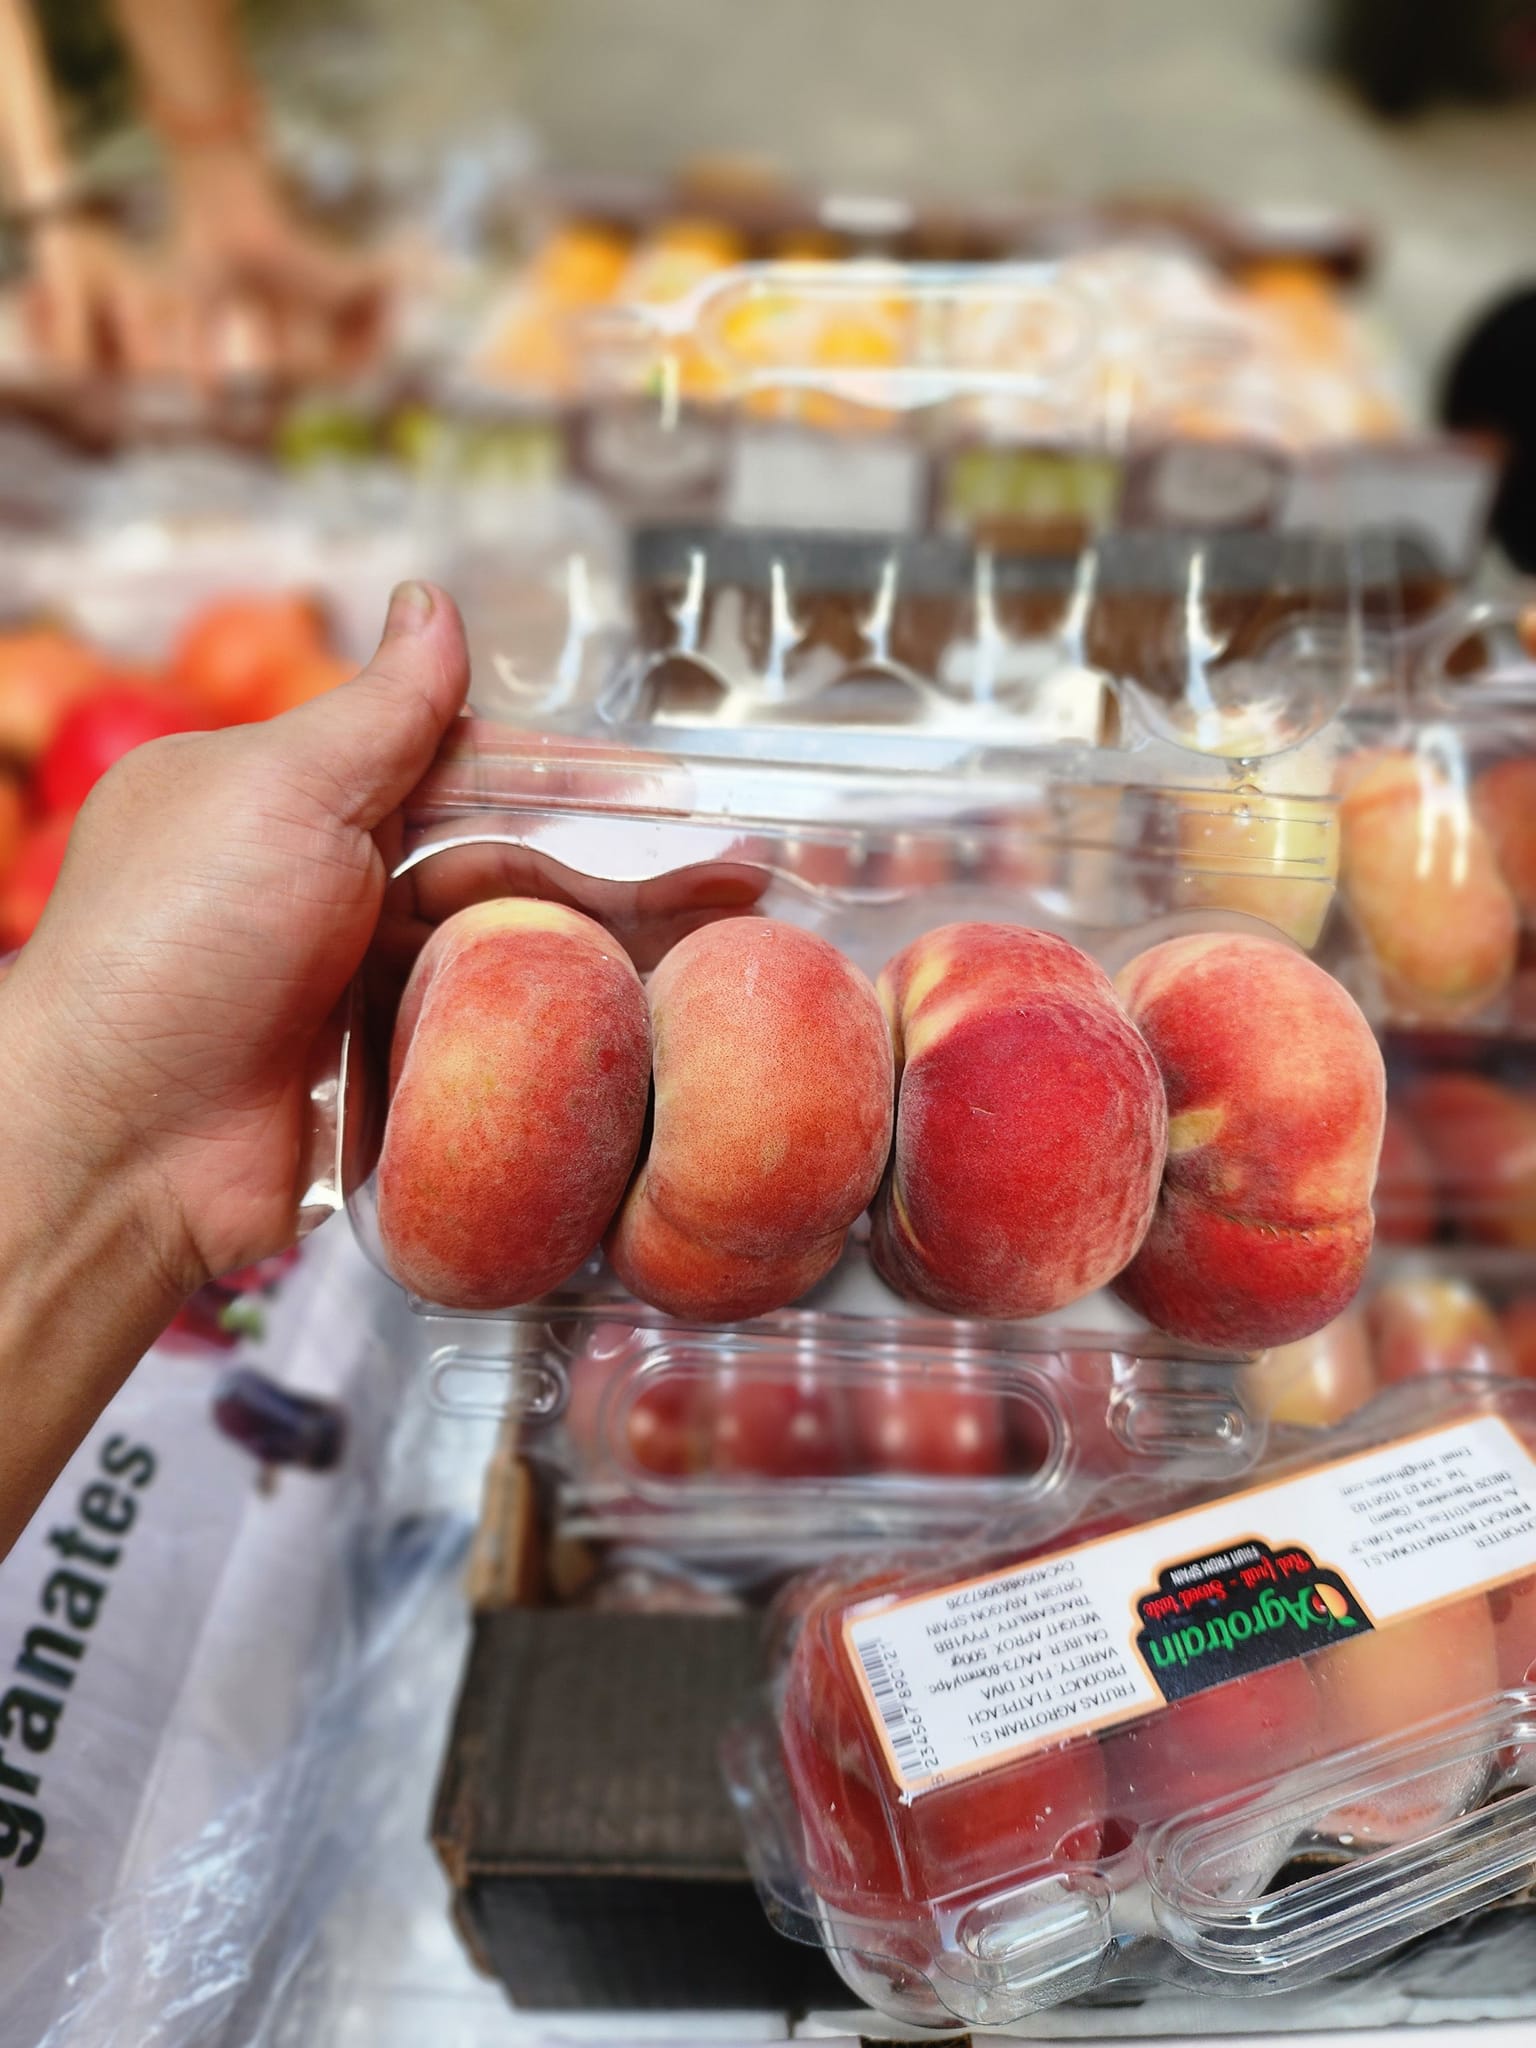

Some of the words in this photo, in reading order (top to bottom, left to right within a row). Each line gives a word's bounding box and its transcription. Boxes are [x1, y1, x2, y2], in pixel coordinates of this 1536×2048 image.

[1203, 1554, 1231, 1576] FROM
[1231, 1545, 1260, 1565] FRUIT
[1276, 1552, 1311, 1578] Red
[1170, 1563, 1204, 1587] SPAIN
[1179, 1579, 1228, 1610] Sweet
[1044, 1608, 1100, 1635] WEIGHT
[1149, 1586, 1313, 1668] Agrotrain
[0, 1433, 157, 1905] granates
[1016, 1667, 1053, 1687] FLAT
[980, 1680, 1015, 1700] DIVA
[1078, 1681, 1137, 1709] FRUTAS
[966, 1689, 1051, 1725] FLATPEACH
[992, 1701, 1079, 1739] AGROTRAIN
